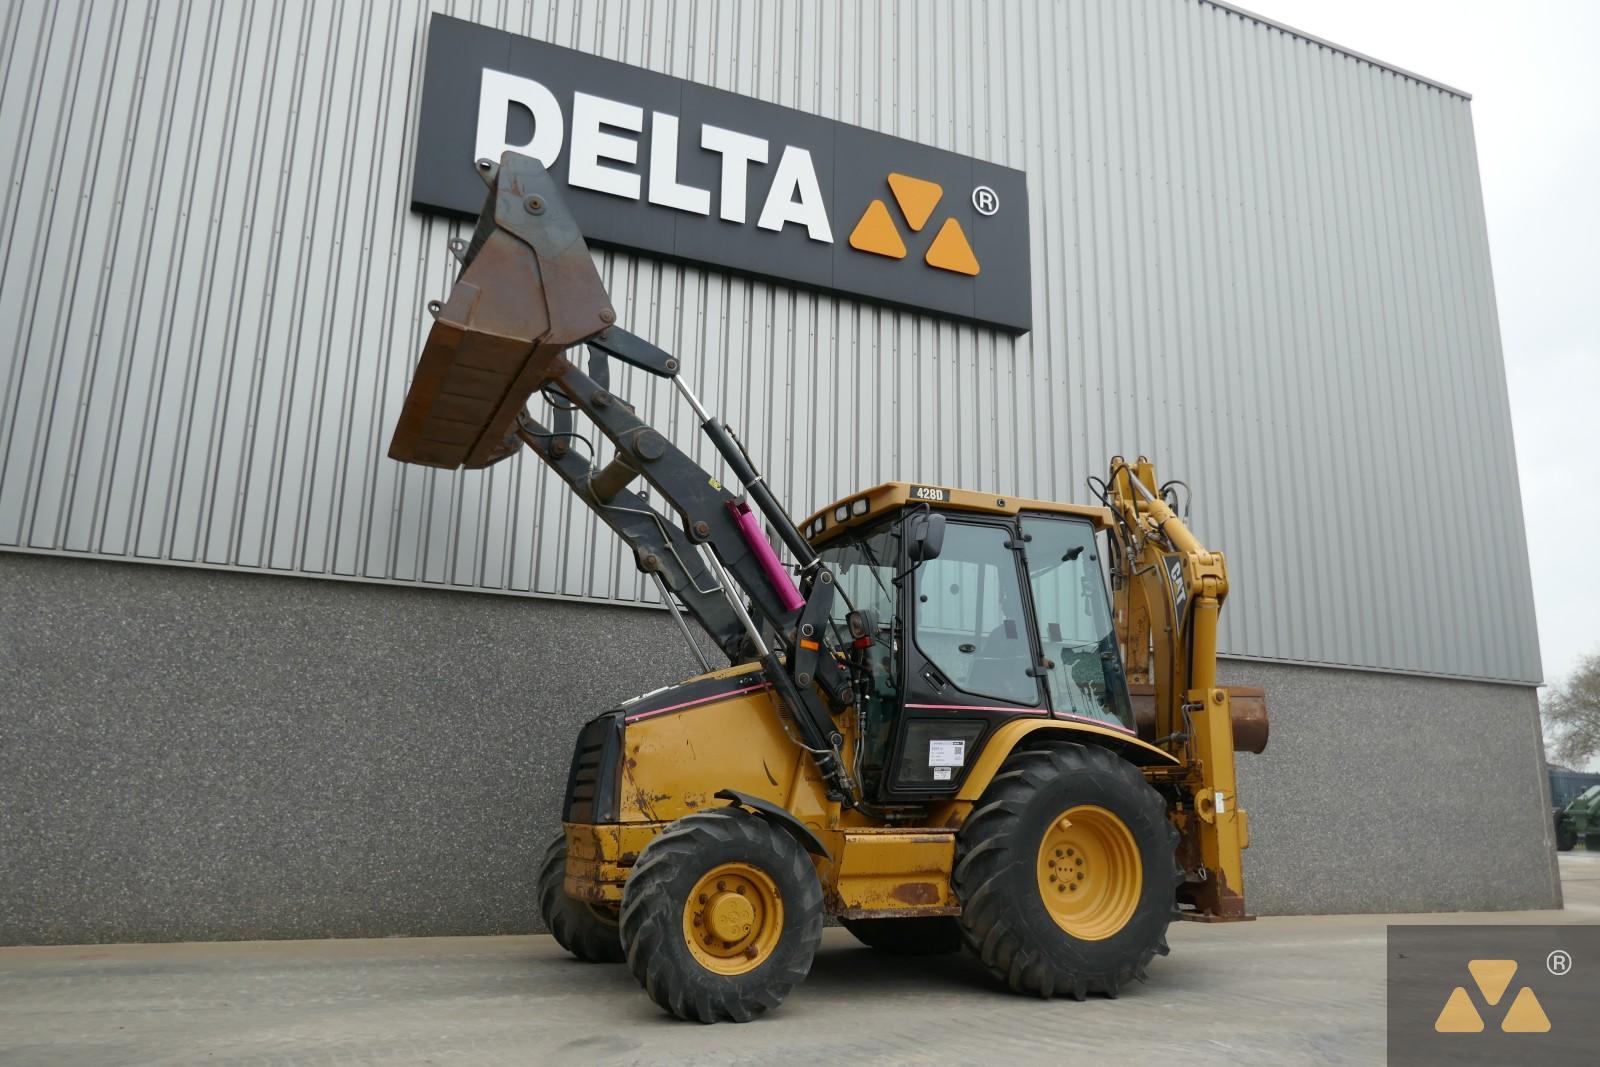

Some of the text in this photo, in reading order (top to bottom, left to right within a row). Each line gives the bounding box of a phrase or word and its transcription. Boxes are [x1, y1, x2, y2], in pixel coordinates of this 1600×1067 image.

[475, 67, 835, 243] DELTA
[917, 487, 943, 501] 428D
[1171, 561, 1187, 606] CAT
